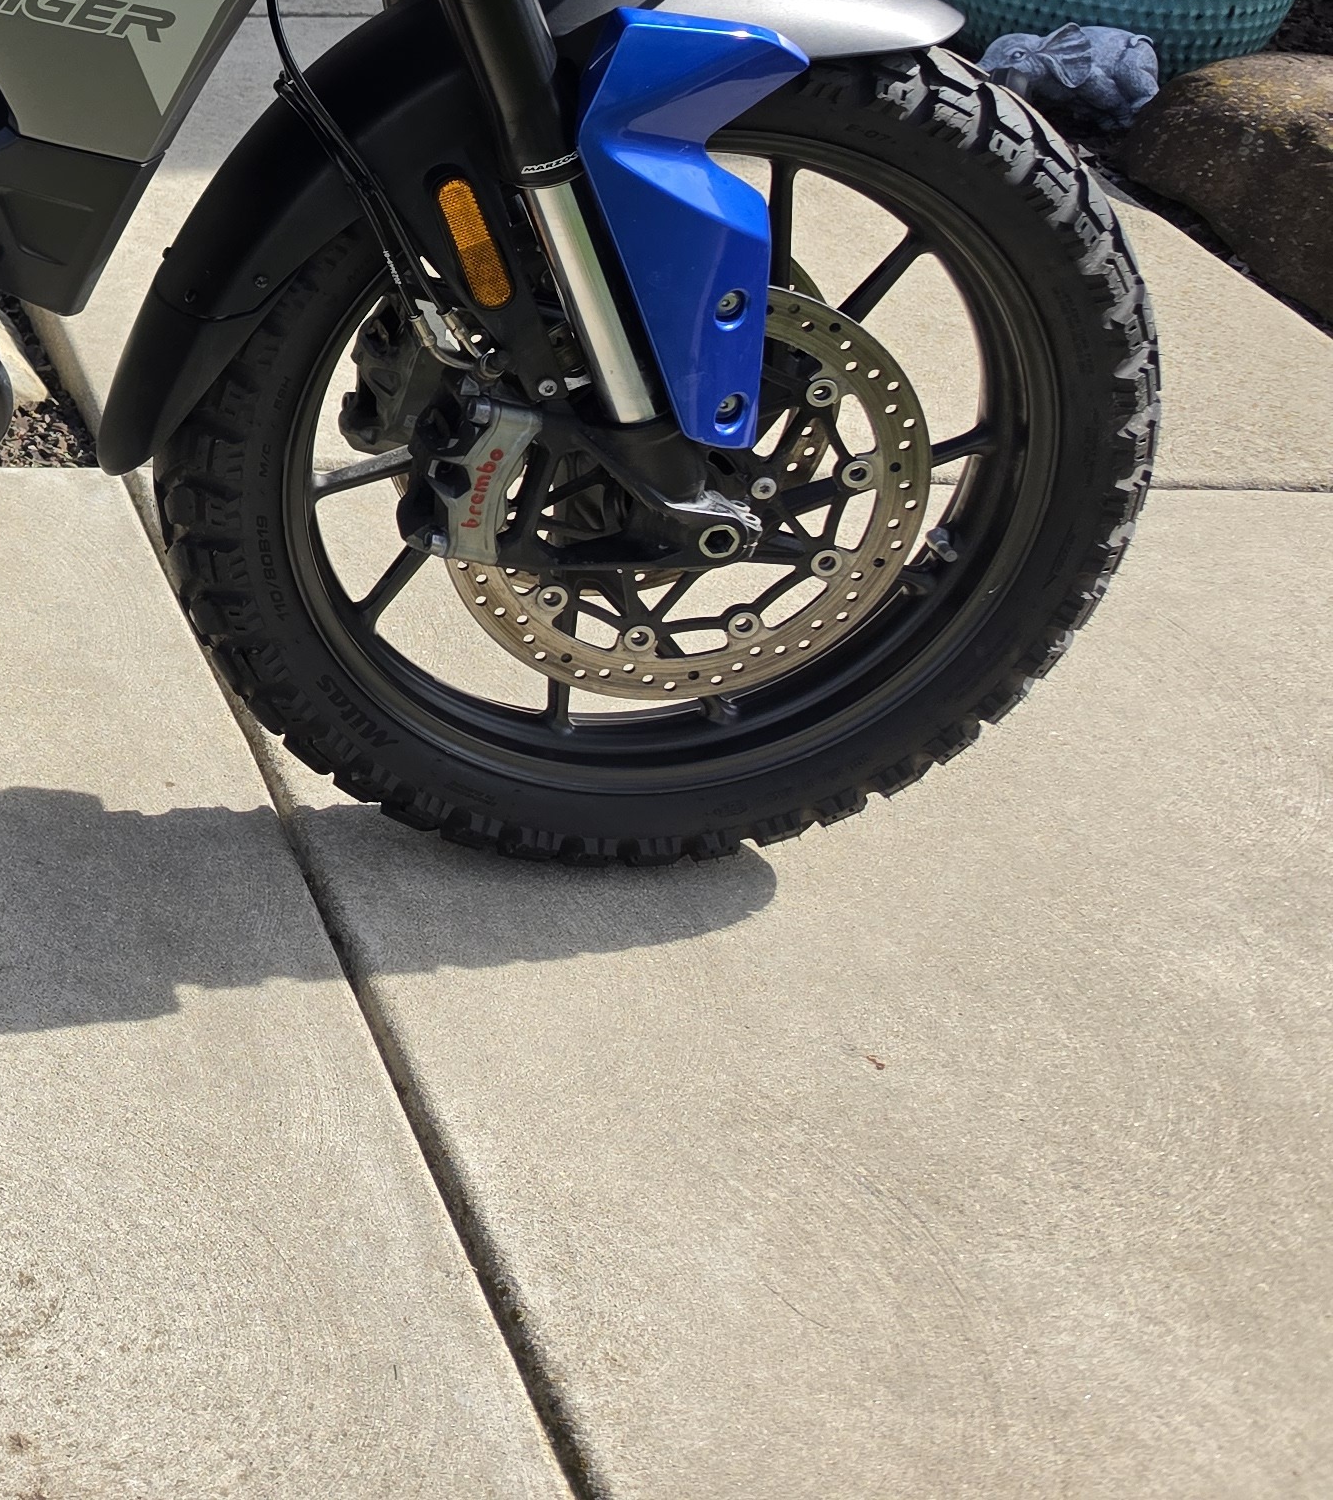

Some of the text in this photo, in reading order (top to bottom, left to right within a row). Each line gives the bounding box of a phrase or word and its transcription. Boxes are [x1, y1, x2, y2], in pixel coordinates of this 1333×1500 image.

[258, 443, 273, 478] M/C
[461, 447, 504, 529] brembo
[257, 515, 287, 621] 110/80B19
[316, 674, 399, 748] Mitas
